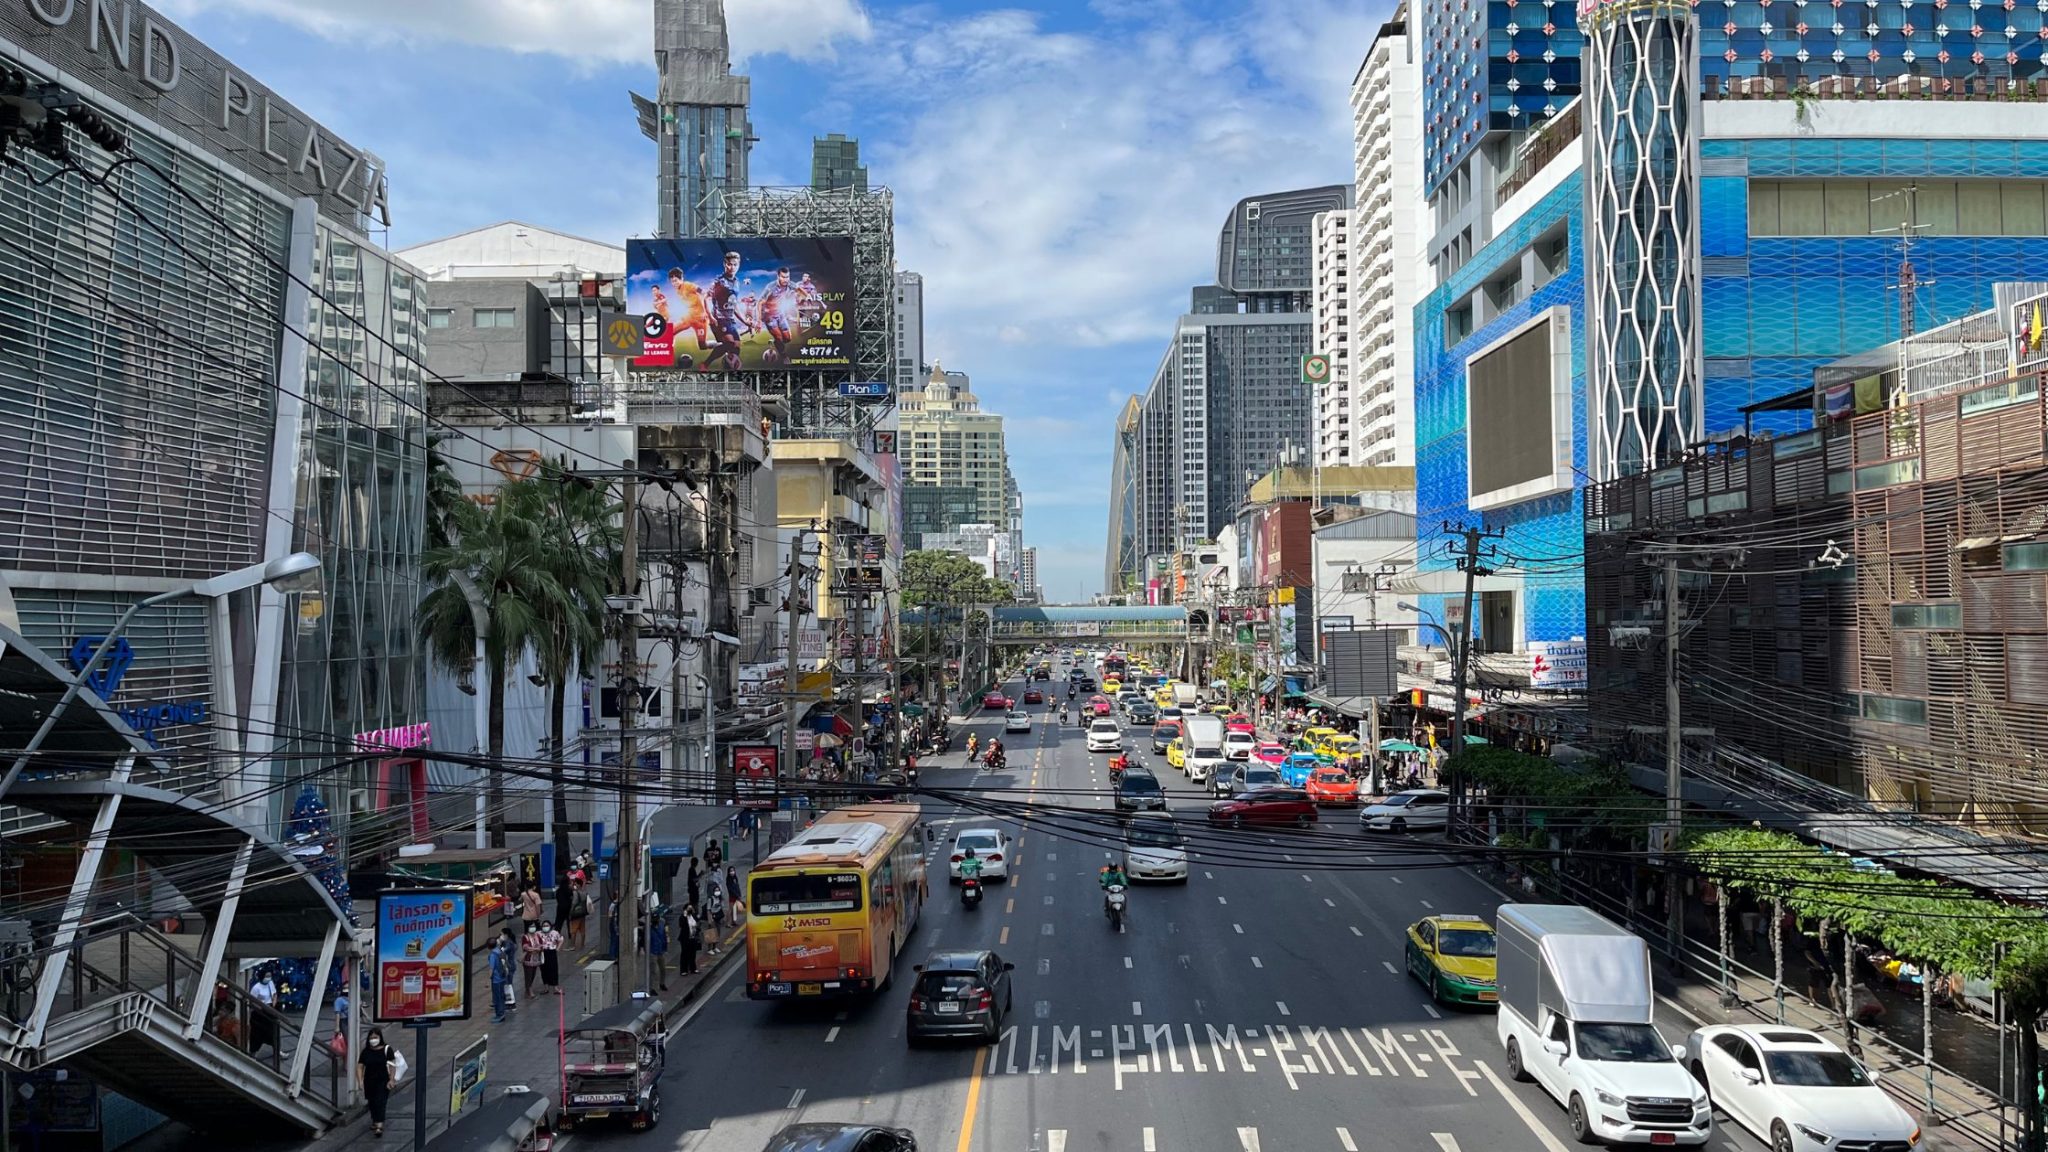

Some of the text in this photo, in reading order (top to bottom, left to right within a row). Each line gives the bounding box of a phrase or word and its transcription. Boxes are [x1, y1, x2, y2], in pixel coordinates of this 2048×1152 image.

[218, 69, 392, 226] PLAZA
[819, 311, 844, 330] 49
[768, 904, 780, 912] 79
